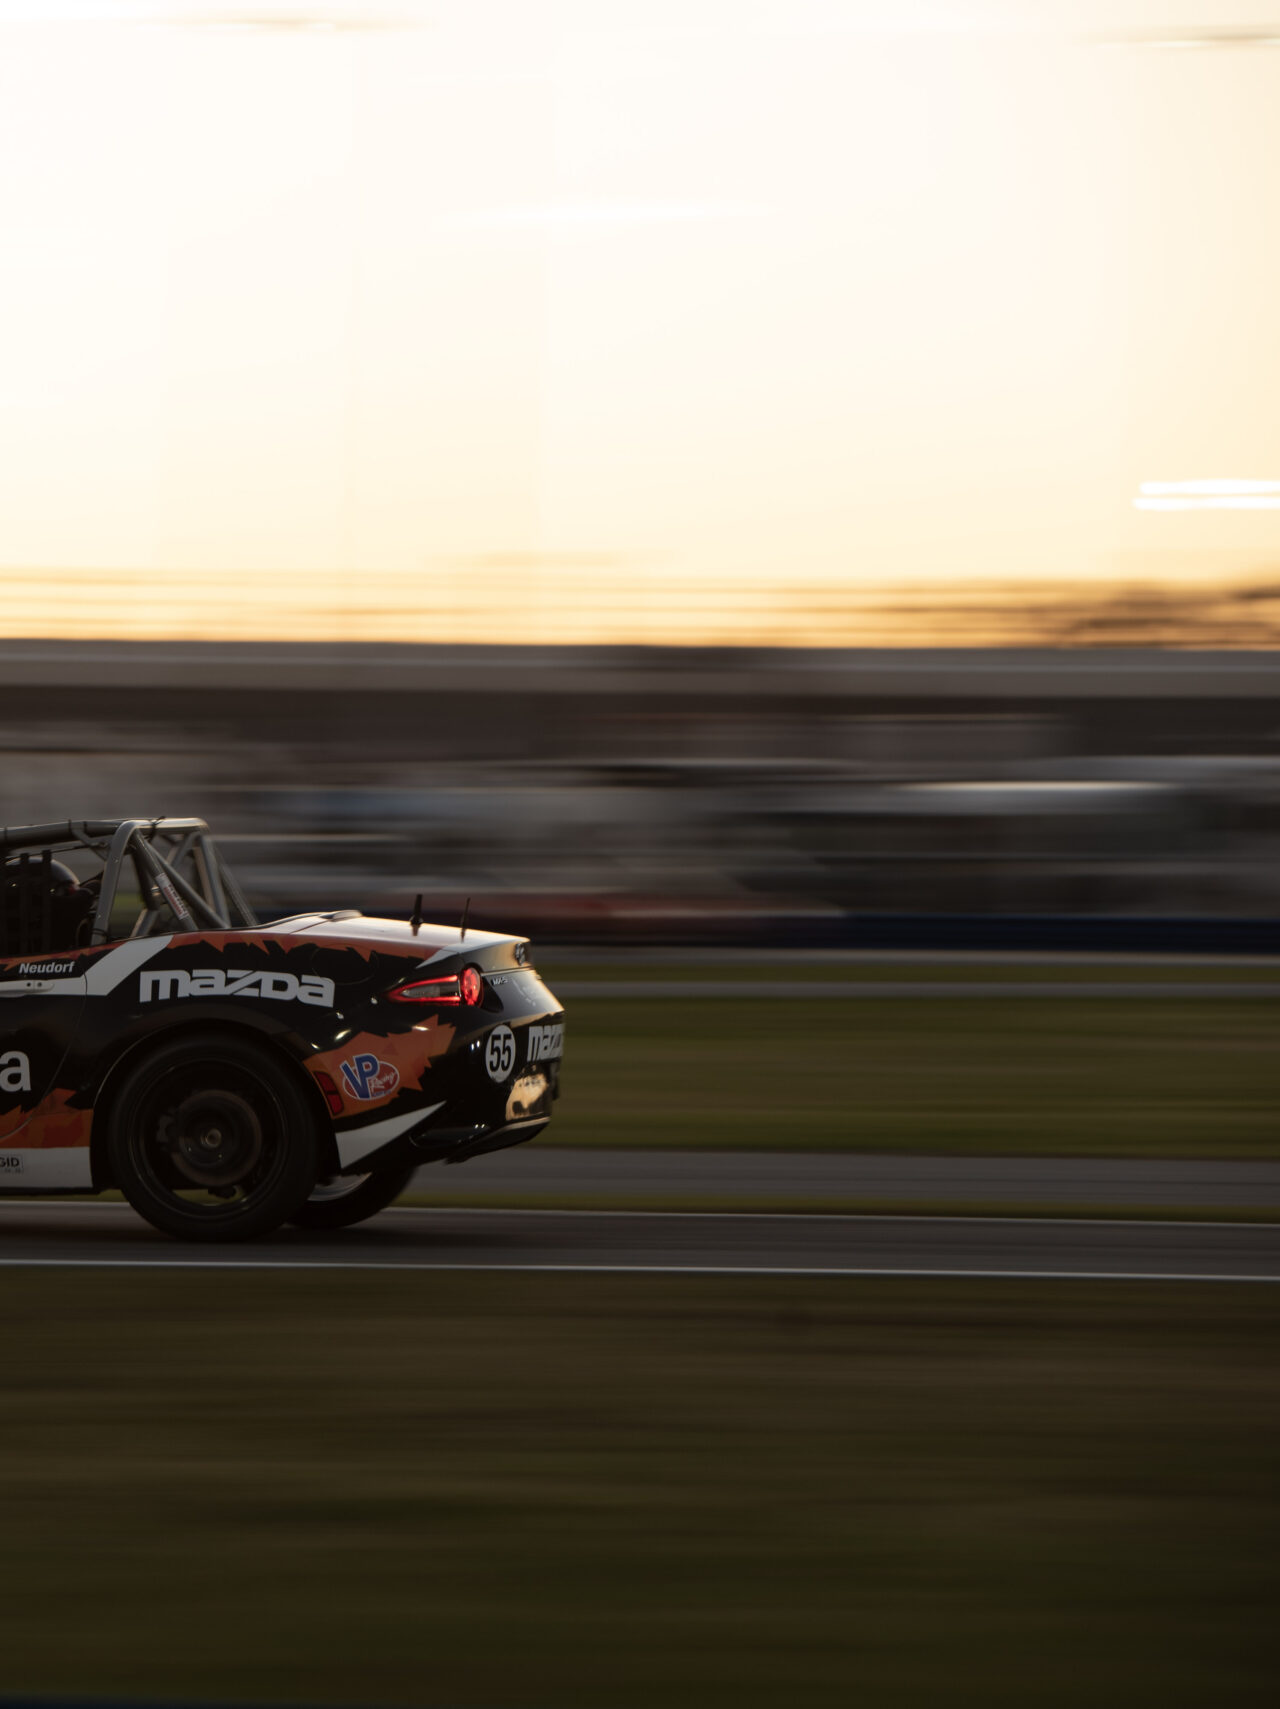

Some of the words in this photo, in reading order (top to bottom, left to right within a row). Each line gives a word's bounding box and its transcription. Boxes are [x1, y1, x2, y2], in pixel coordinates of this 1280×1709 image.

[19, 961, 75, 974] Neudorf
[490, 1034, 512, 1072] 55
[339, 1053, 380, 1099] VP
